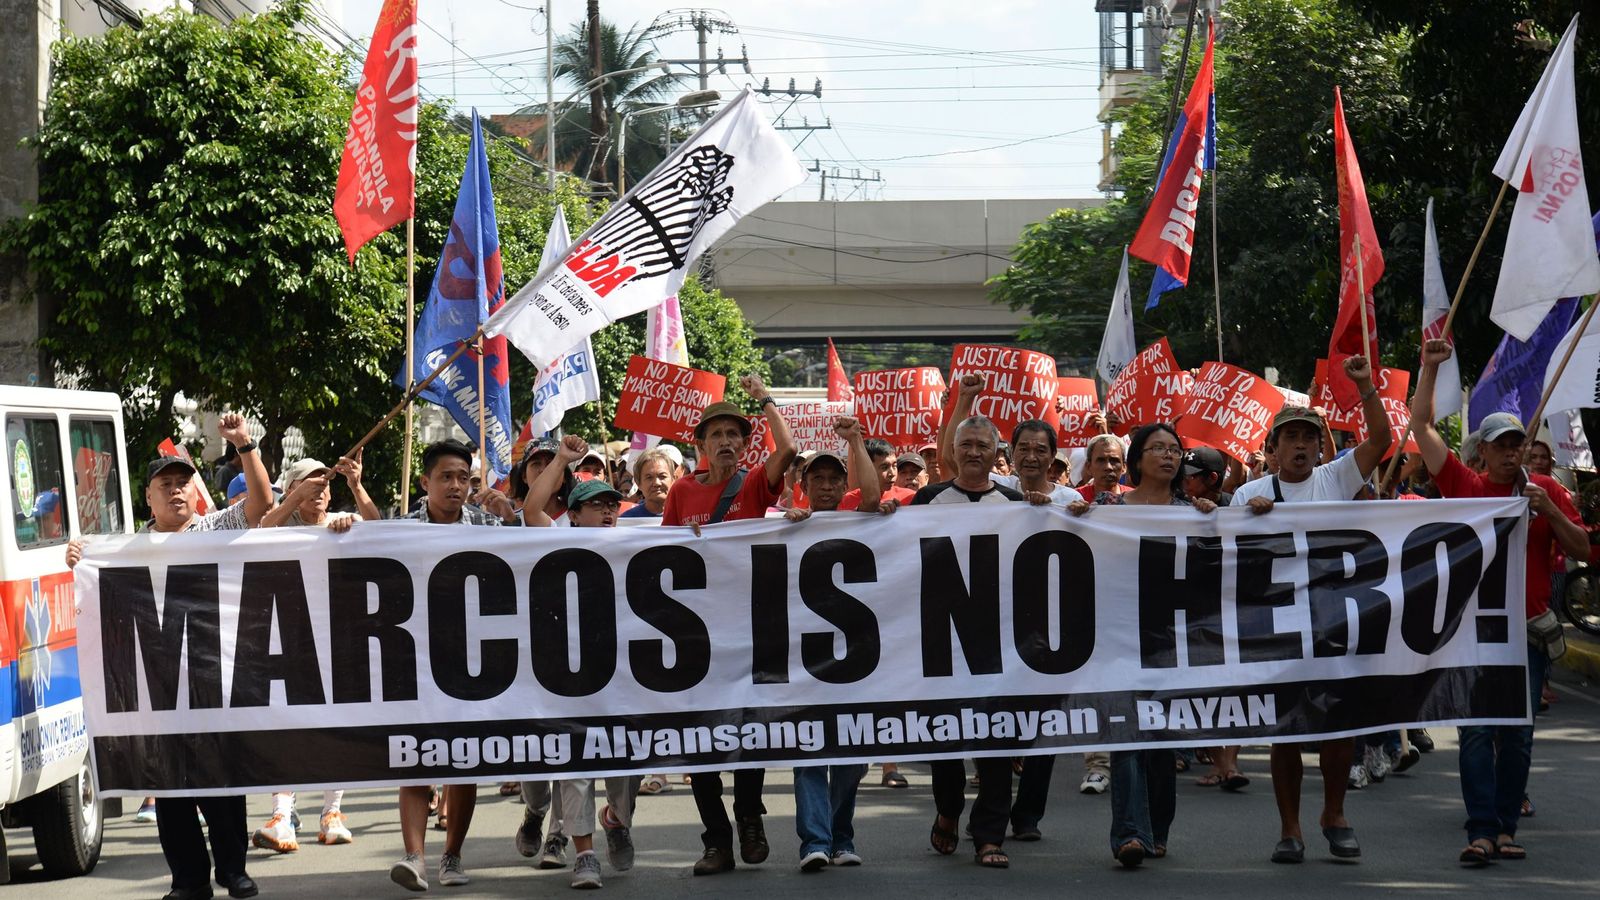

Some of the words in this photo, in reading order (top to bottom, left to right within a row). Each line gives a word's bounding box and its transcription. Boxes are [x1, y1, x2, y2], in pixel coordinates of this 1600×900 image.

[957, 347, 1020, 370] JUSTICE
[1025, 354, 1053, 378] FOR
[1142, 343, 1163, 368] FOR
[644, 360, 668, 380] NO
[673, 368, 694, 386] TO
[857, 370, 917, 392] JUSTICE
[922, 369, 942, 386] FOR
[1204, 363, 1228, 382] NO
[1228, 371, 1255, 393] TO
[624, 375, 674, 401] MARCOS
[630, 395, 652, 415] AT
[826, 404, 846, 414] and
[855, 391, 916, 415] MARTIAL
[1186, 398, 1206, 415] AT
[1189, 381, 1229, 402] MARCOS
[1228, 391, 1272, 431] BURIAL
[793, 429, 811, 440] ALL
[99, 545, 711, 713] MARCOS
[751, 538, 880, 685] IS
[919, 530, 1096, 678] NO
[1138, 516, 1521, 669] HERO!
[389, 733, 571, 769] Bagong
[582, 719, 825, 761] Alyansang
[837, 706, 1098, 746] Makabayan
[1137, 693, 1277, 731] BAYAN
